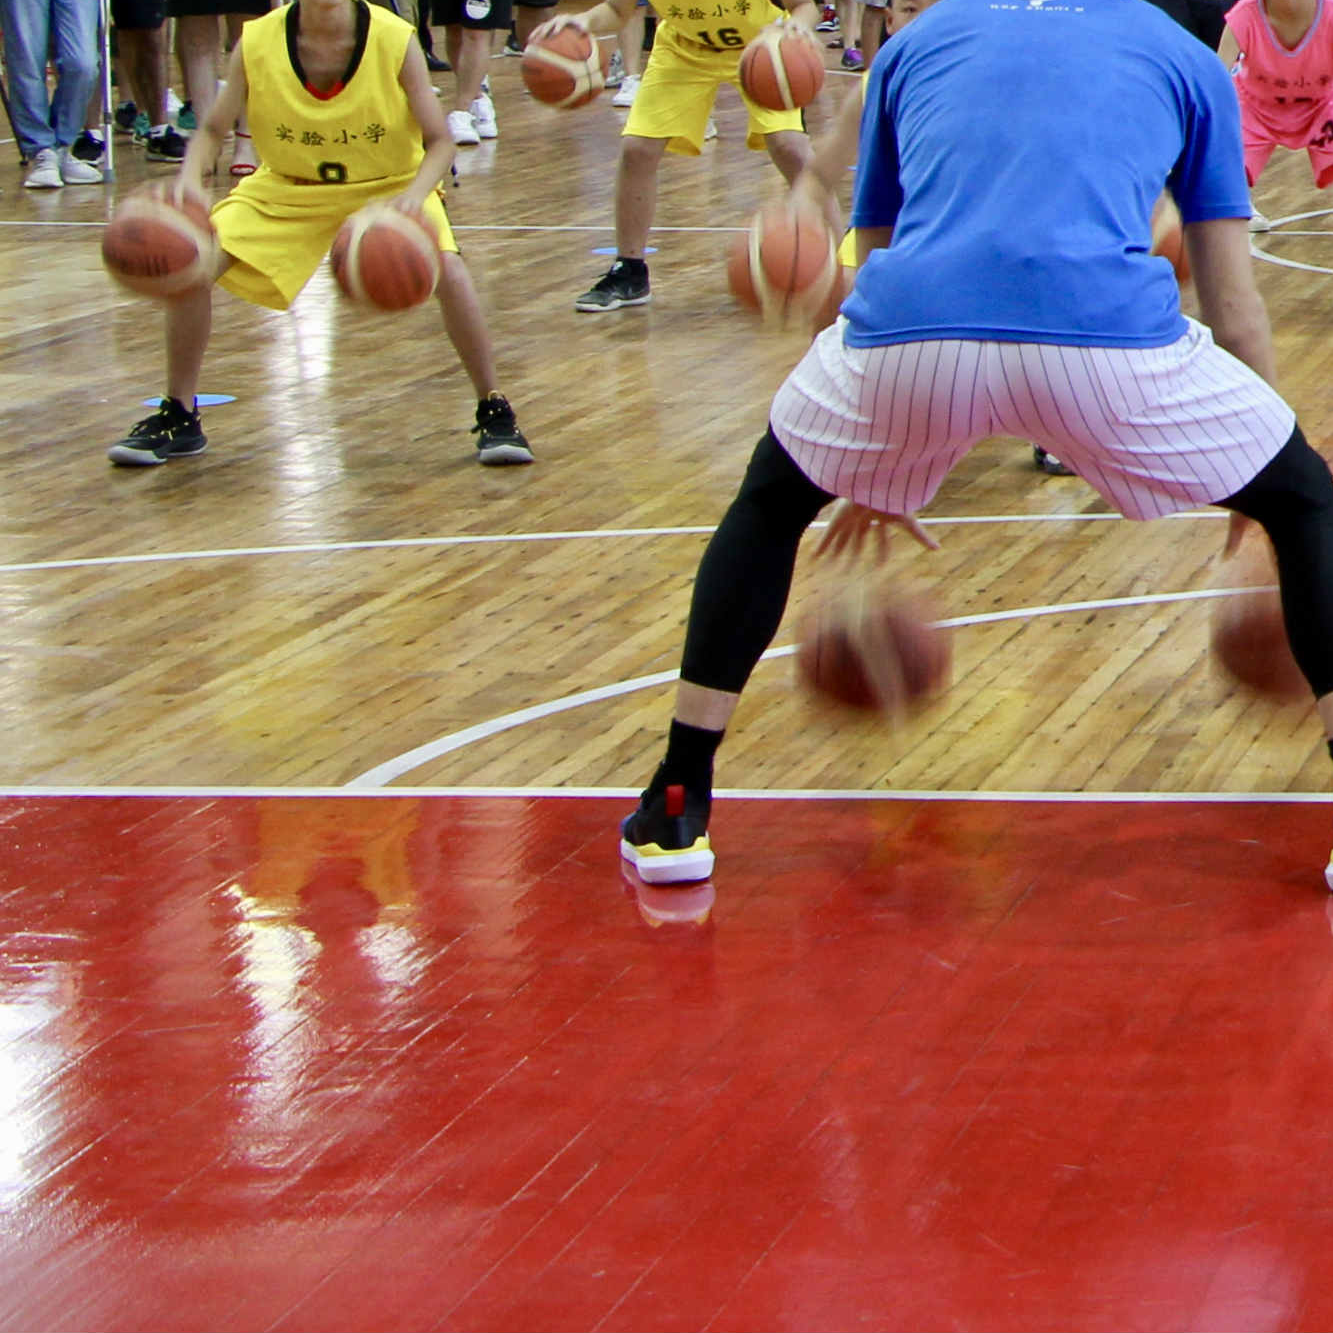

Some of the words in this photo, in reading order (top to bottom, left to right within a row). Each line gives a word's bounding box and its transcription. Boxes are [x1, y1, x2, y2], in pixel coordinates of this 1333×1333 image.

[697, 27, 744, 53] 16
[275, 123, 386, 146] 实验小学
